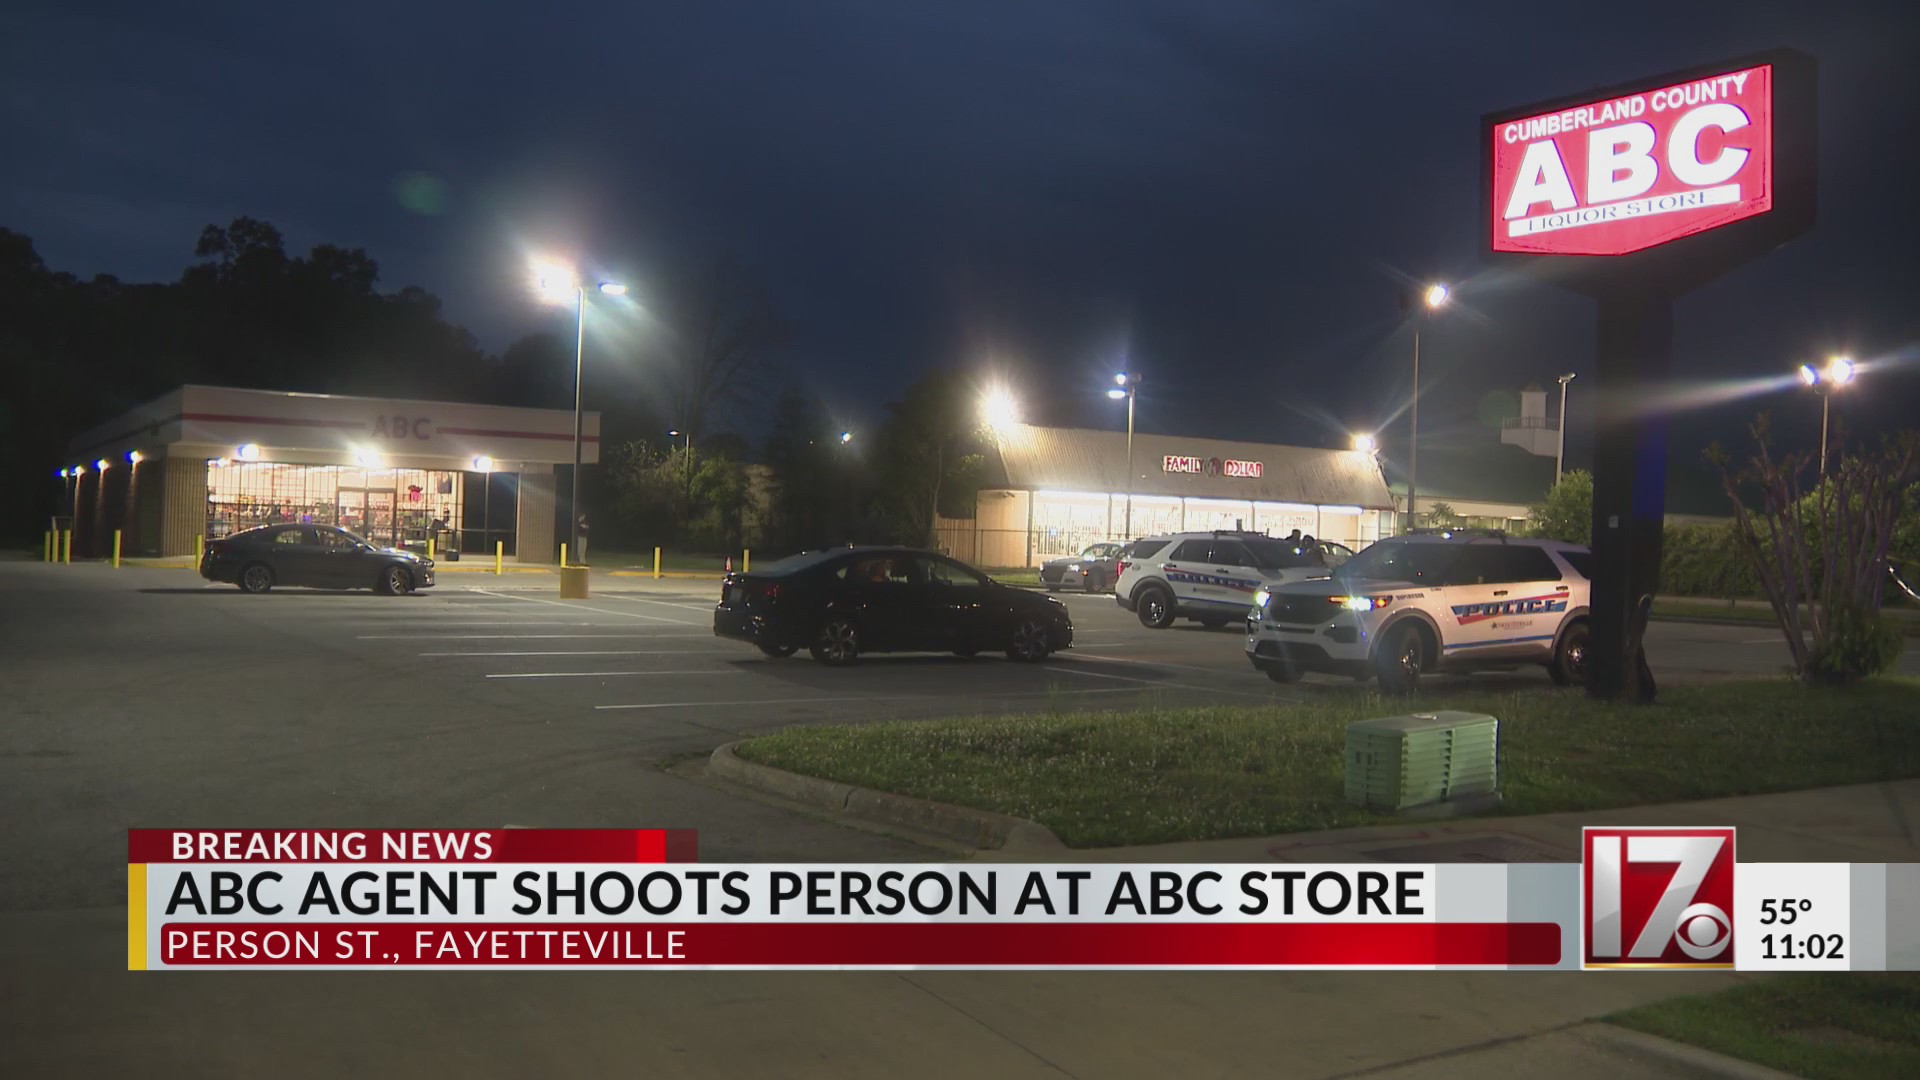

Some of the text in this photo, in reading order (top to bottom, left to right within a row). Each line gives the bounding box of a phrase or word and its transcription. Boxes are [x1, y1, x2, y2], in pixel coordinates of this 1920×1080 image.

[1504, 72, 1748, 144] CUMBERLAND COUNTY
[1502, 102, 1752, 221] ABC
[1527, 190, 1717, 232] LIQUOR STORE
[371, 415, 431, 440] ABC
[1163, 455, 1264, 478] FAMILY DOLLAR
[1462, 600, 1555, 617] POLICE
